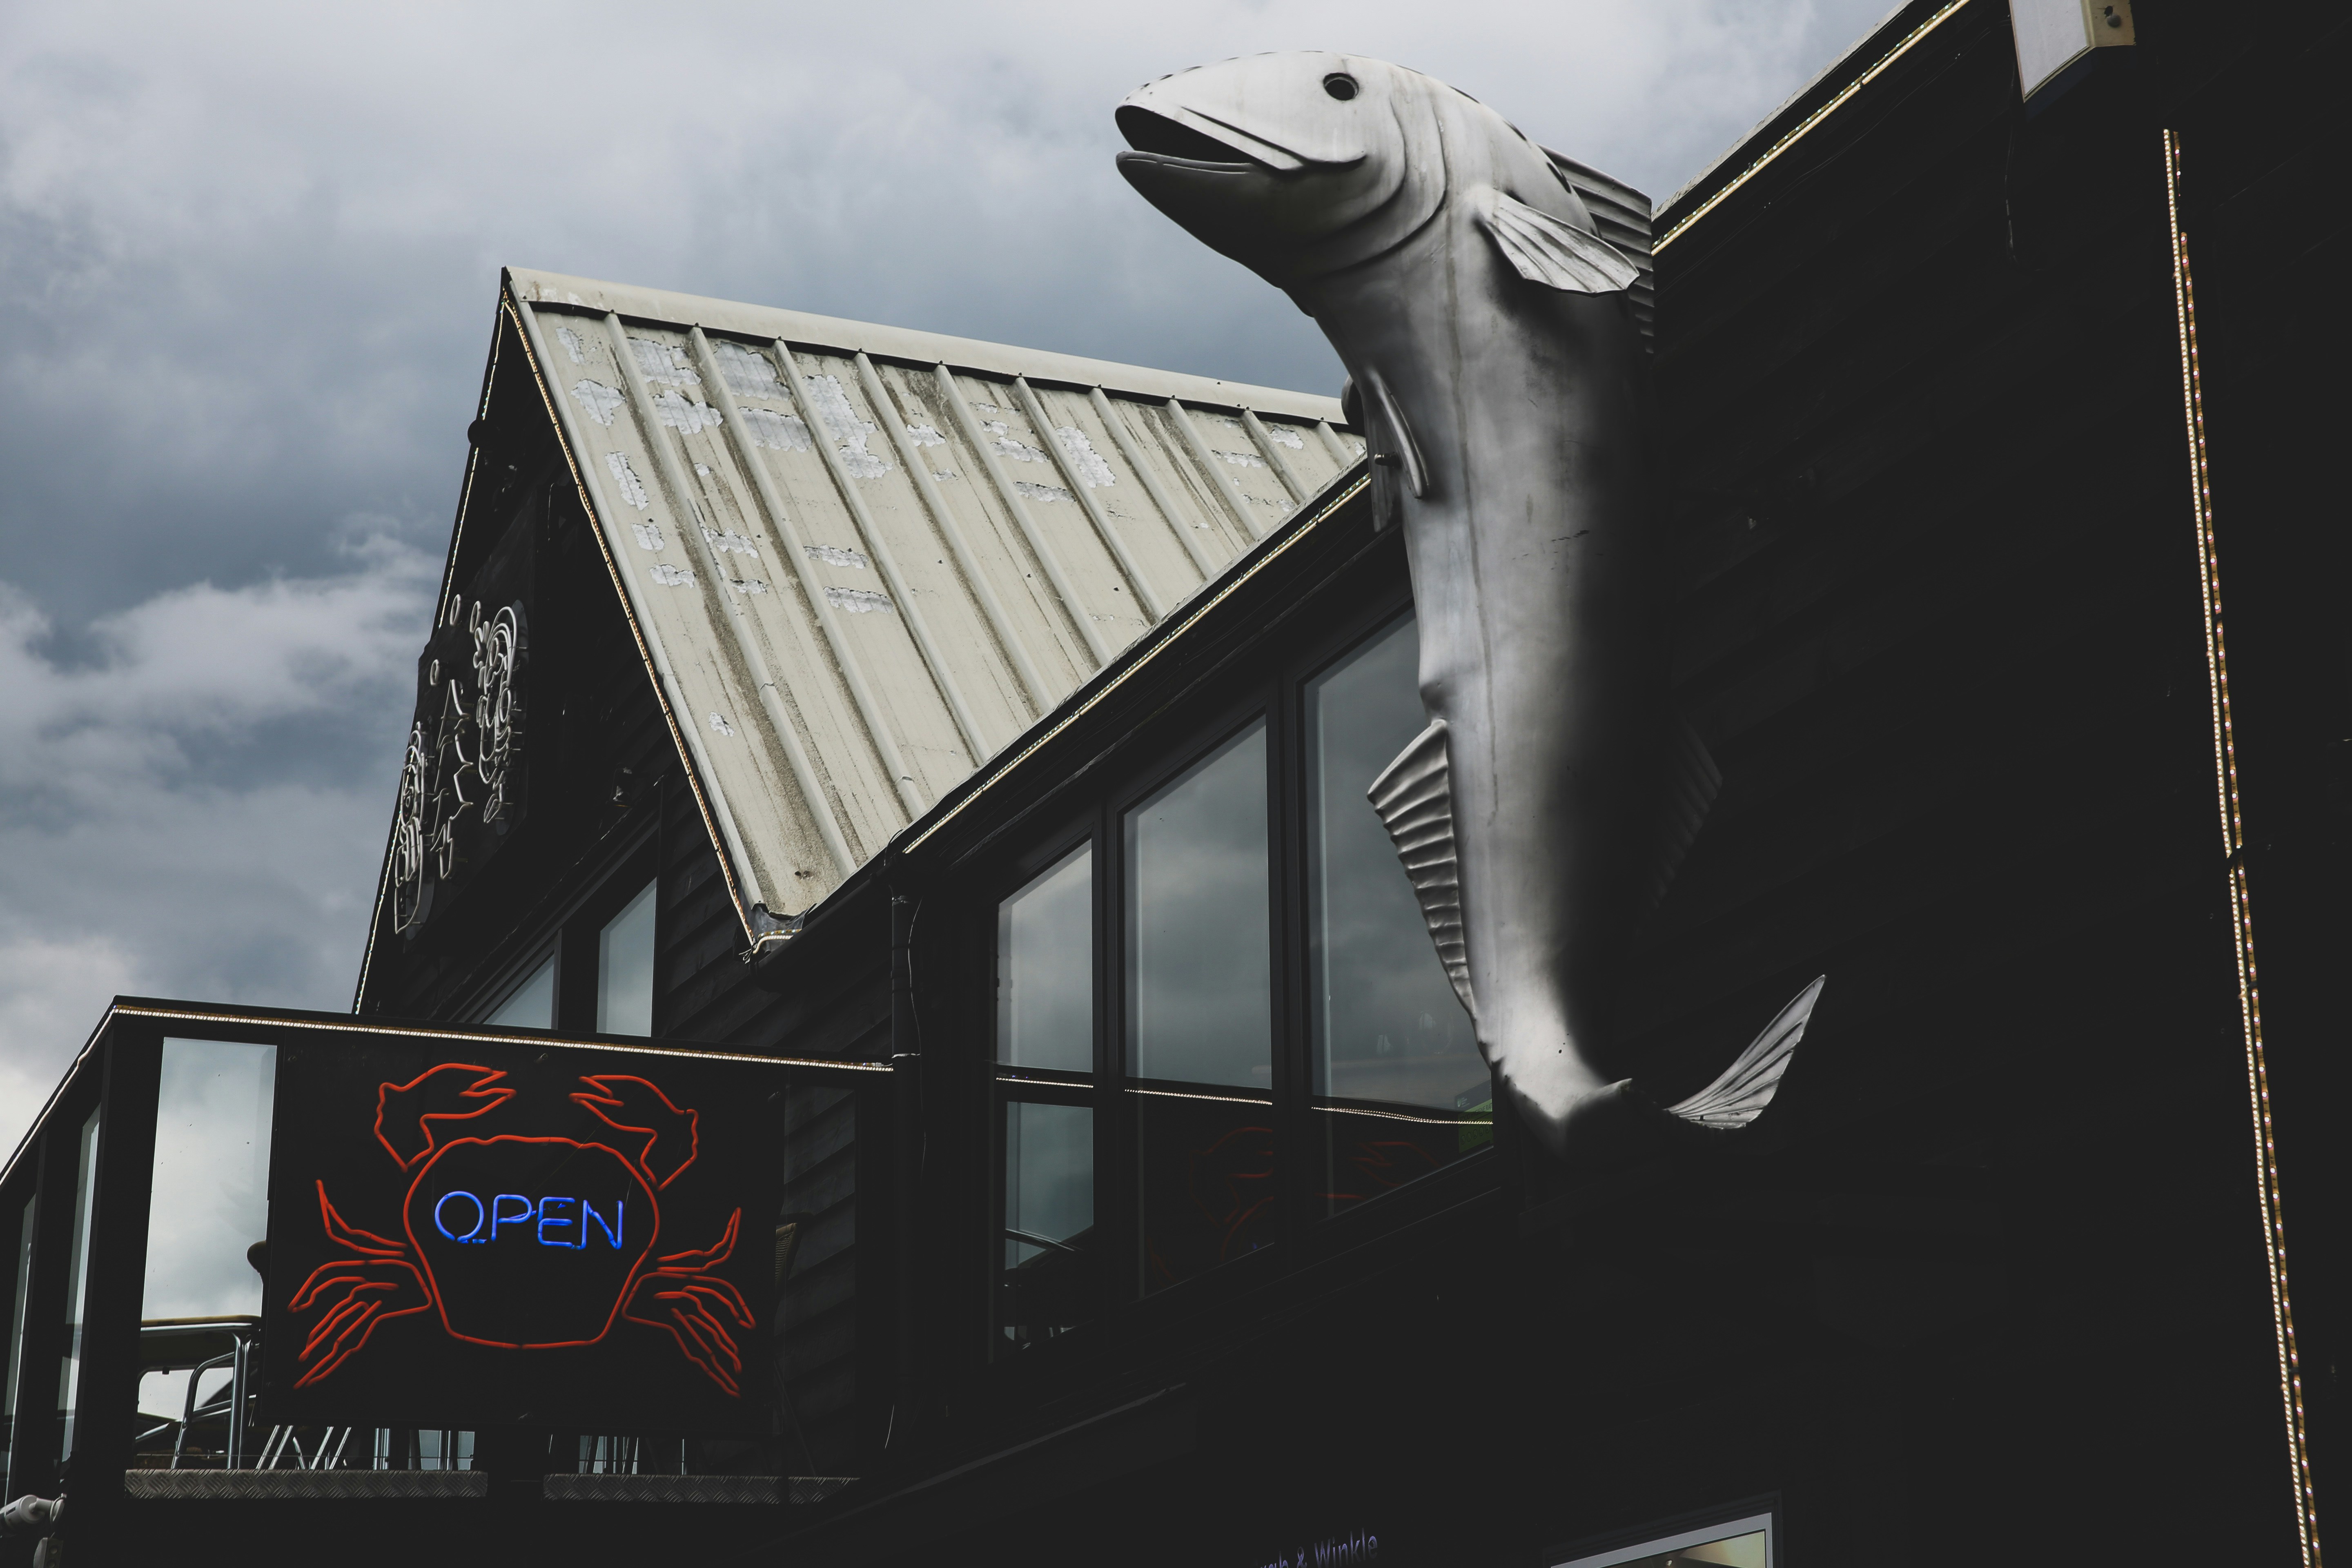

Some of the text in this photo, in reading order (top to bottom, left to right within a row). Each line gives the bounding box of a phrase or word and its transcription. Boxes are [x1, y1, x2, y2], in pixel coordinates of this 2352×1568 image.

[435, 1191, 623, 1250] OPEN
[1296, 1546, 1307, 1568] &
[1314, 1527, 1378, 1568] Winkle
